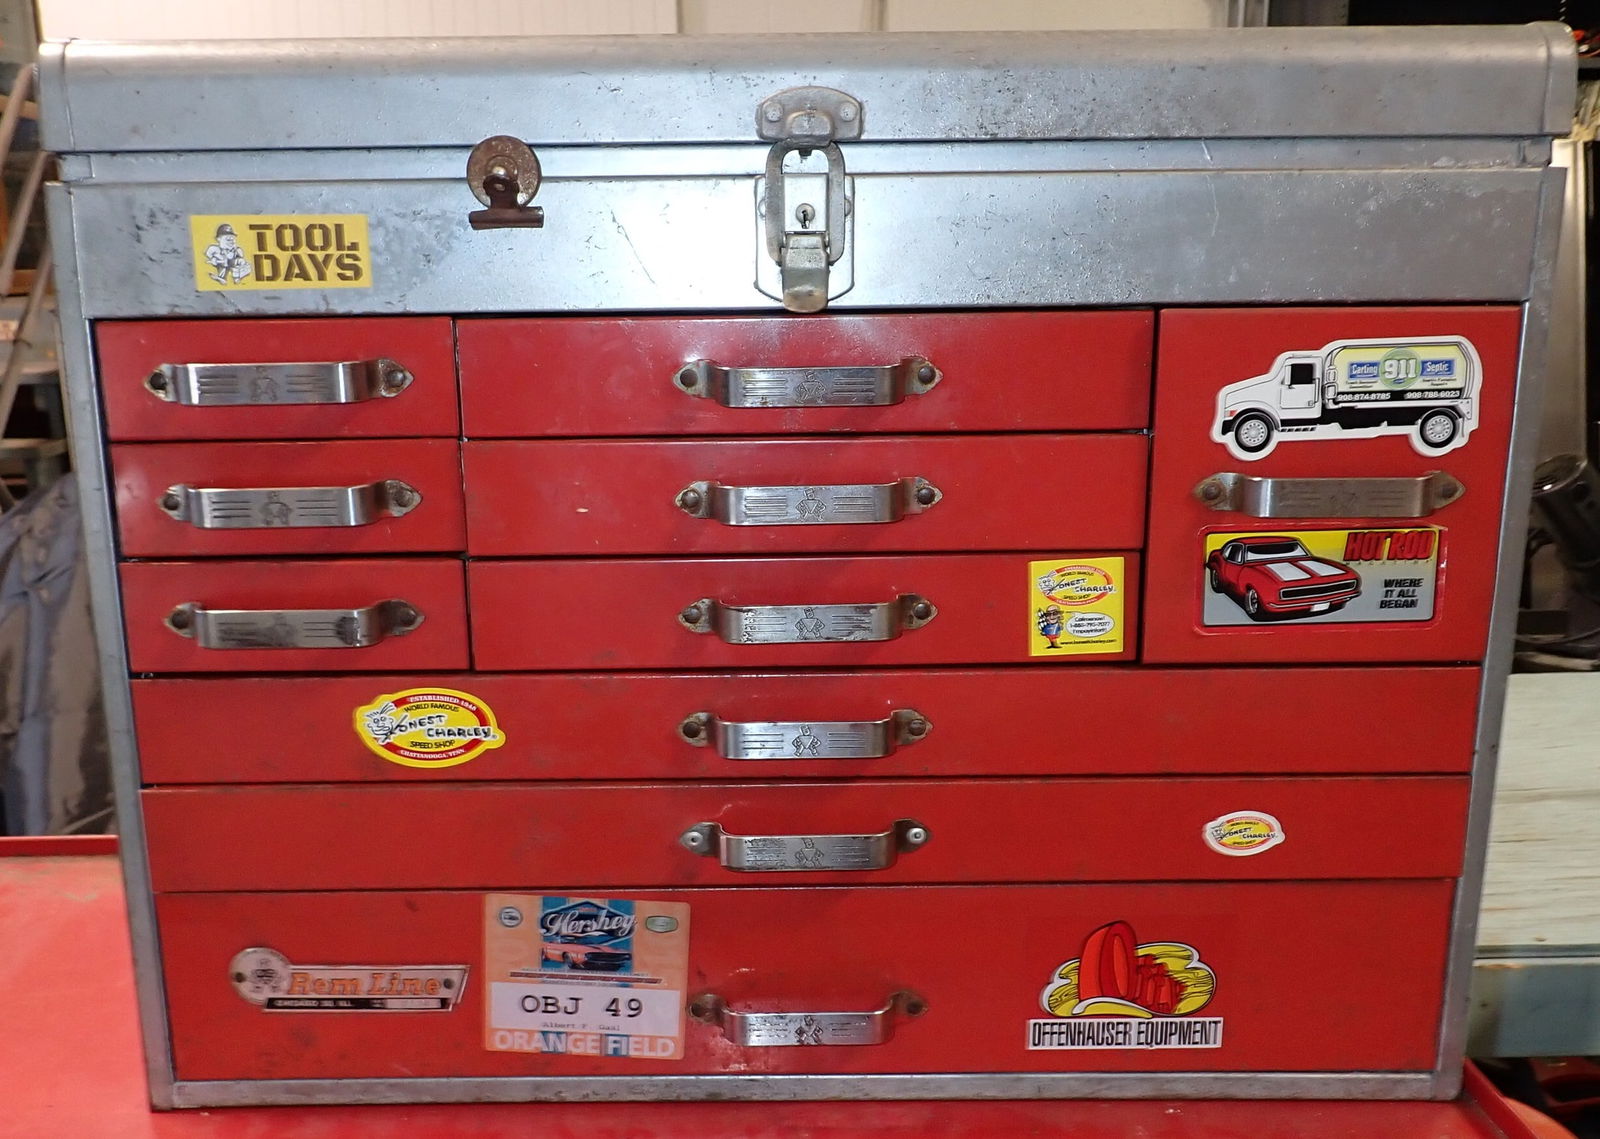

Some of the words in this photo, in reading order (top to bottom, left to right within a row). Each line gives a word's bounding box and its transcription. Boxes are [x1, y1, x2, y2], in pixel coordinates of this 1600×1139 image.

[249, 223, 360, 252] TOOL
[253, 253, 364, 282] DAYS
[1383, 358, 1417, 379] 911
[1343, 531, 1389, 561] HOT
[1387, 530, 1436, 560] ROD
[1383, 578, 1424, 588] WHERE
[1384, 589, 1395, 598] IT
[1397, 588, 1418, 598] ALL
[1379, 599, 1419, 609] BEGAN
[404, 703, 430, 713] WORLD
[430, 703, 460, 712] FAMOUS
[410, 740, 434, 749] SPEED
[434, 739, 456, 748] SHOP
[426, 727, 493, 739] CHARLEY
[540, 909, 638, 937] Hershey
[286, 971, 363, 996] Rem
[366, 971, 442, 996] Line
[520, 994, 583, 1015] OBJ
[604, 996, 644, 1018] 49
[494, 1030, 600, 1054] ORANGE
[605, 1034, 676, 1058] FIELD
[1031, 1021, 1133, 1047] OFFENHAUSER
[1136, 1020, 1222, 1047] EQUIPMENT
